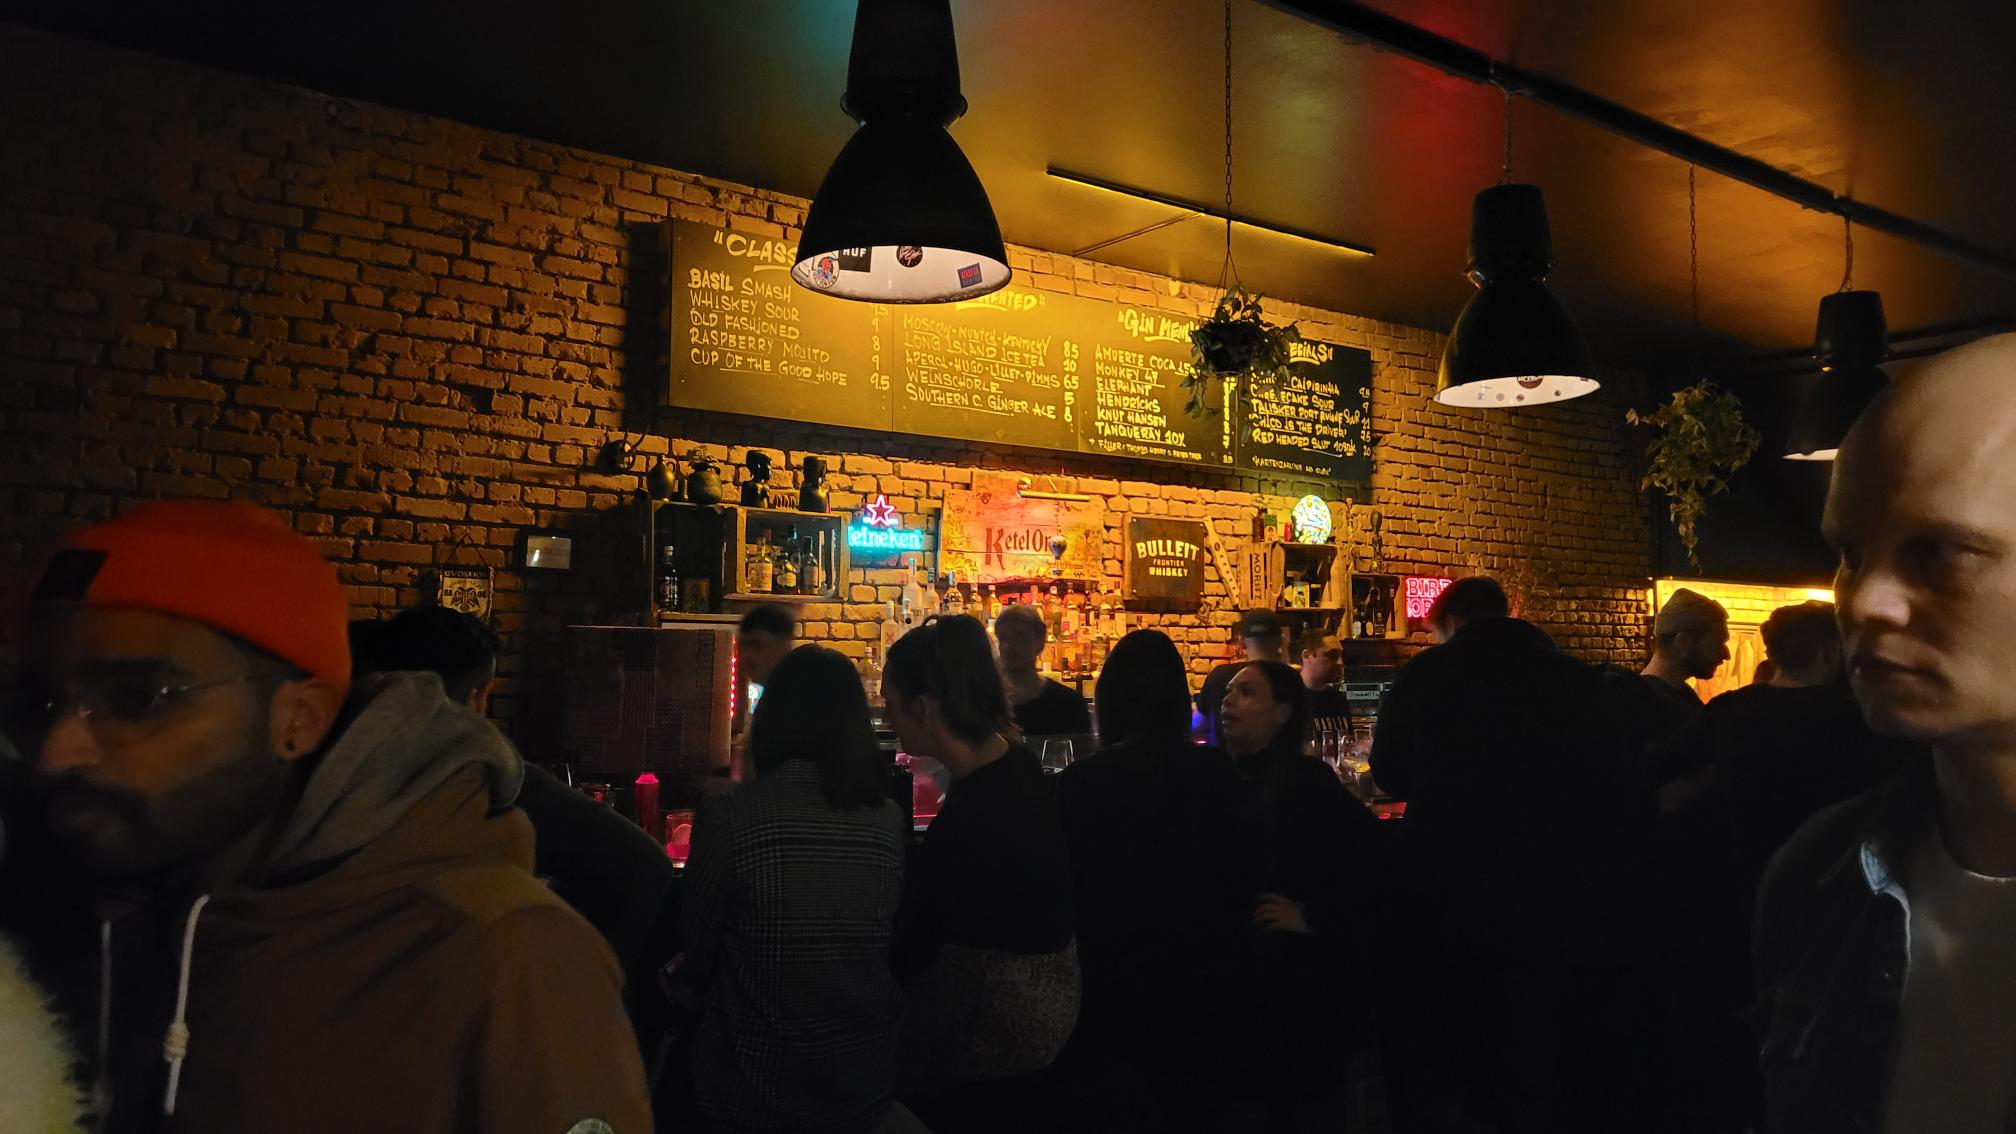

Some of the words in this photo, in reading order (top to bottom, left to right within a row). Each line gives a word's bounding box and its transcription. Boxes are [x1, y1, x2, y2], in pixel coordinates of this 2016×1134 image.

[714, 230, 798, 267] "CLASS
[741, 277, 792, 303] SMASH
[765, 302, 800, 322] SOUR
[690, 308, 718, 326] OLD
[872, 335, 881, 352] 8
[690, 327, 774, 355] RASPBERRY
[872, 354, 880, 371] 9
[904, 331, 941, 351] LONG
[946, 338, 997, 358] ISLAND
[1001, 346, 1021, 363] ICE
[1023, 352, 1045, 367] TEA
[1063, 358, 1077, 373] 10
[1063, 340, 1079, 359] 85
[691, 348, 719, 366] CUP
[726, 352, 743, 368] OF
[747, 358, 772, 372] THE
[779, 361, 812, 378] GOOD
[817, 367, 848, 386] HOPE
[1095, 361, 1140, 380] MONKEY
[1149, 355, 1176, 371] COCA
[1063, 373, 1079, 389] 65
[906, 383, 970, 405] SOUTHERN
[988, 395, 1029, 413] GINGER
[1032, 402, 1056, 419] ALE
[1064, 392, 1075, 405] 5
[1097, 391, 1161, 412] HENDRICKS
[1311, 394, 1335, 411] SOUR
[1362, 402, 1369, 414] 9
[1097, 405, 1125, 422] KNUT
[1127, 413, 1167, 428] HANSEN
[1251, 398, 1297, 417] TALISKER
[1298, 407, 1319, 420] PORT
[1361, 417, 1370, 430] 11
[1284, 416, 1295, 431] IS
[1296, 420, 1312, 434] THE
[1095, 421, 1161, 441] TANQUERAY
[1252, 428, 1275, 444] RED
[1276, 433, 1310, 448] HEADED
[848, 526, 924, 549] eineken
[986, 528, 1030, 570] Ketel
[1136, 539, 1200, 561] BULLEIT
[1149, 567, 1189, 577] WHISKEY
[1254, 553, 1262, 600] MORITZ
